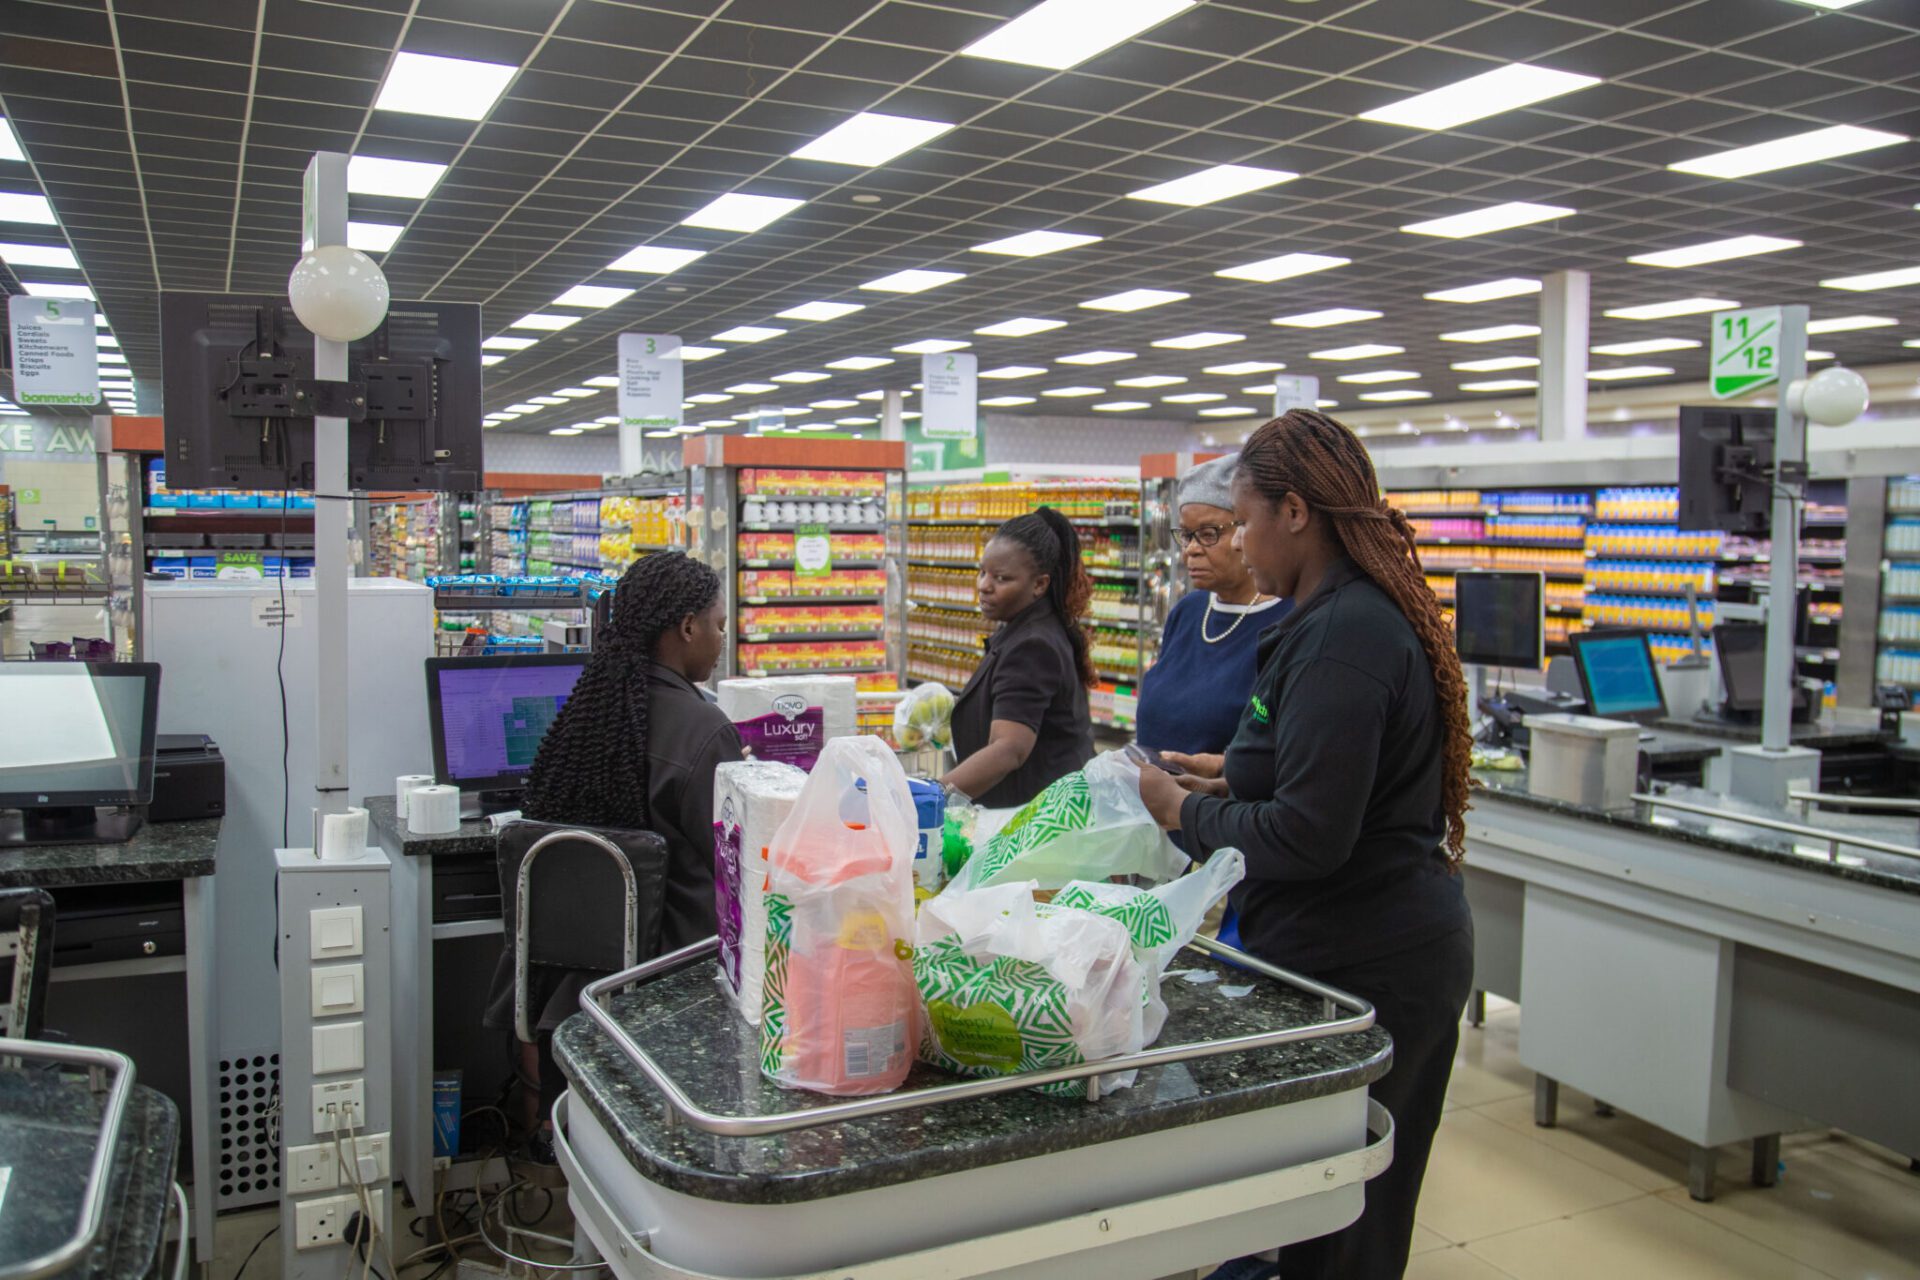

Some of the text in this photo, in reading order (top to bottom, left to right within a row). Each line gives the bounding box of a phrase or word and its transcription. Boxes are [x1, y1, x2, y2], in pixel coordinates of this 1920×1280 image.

[46, 301, 60, 315] 5
[1721, 317, 1748, 339] 11
[645, 338, 656, 354] 3
[945, 356, 955, 371] 2
[1742, 346, 1773, 368] 12
[224, 553, 256, 563] SAVE
[763, 722, 815, 737] Luxury
[794, 733, 809, 741] soft
